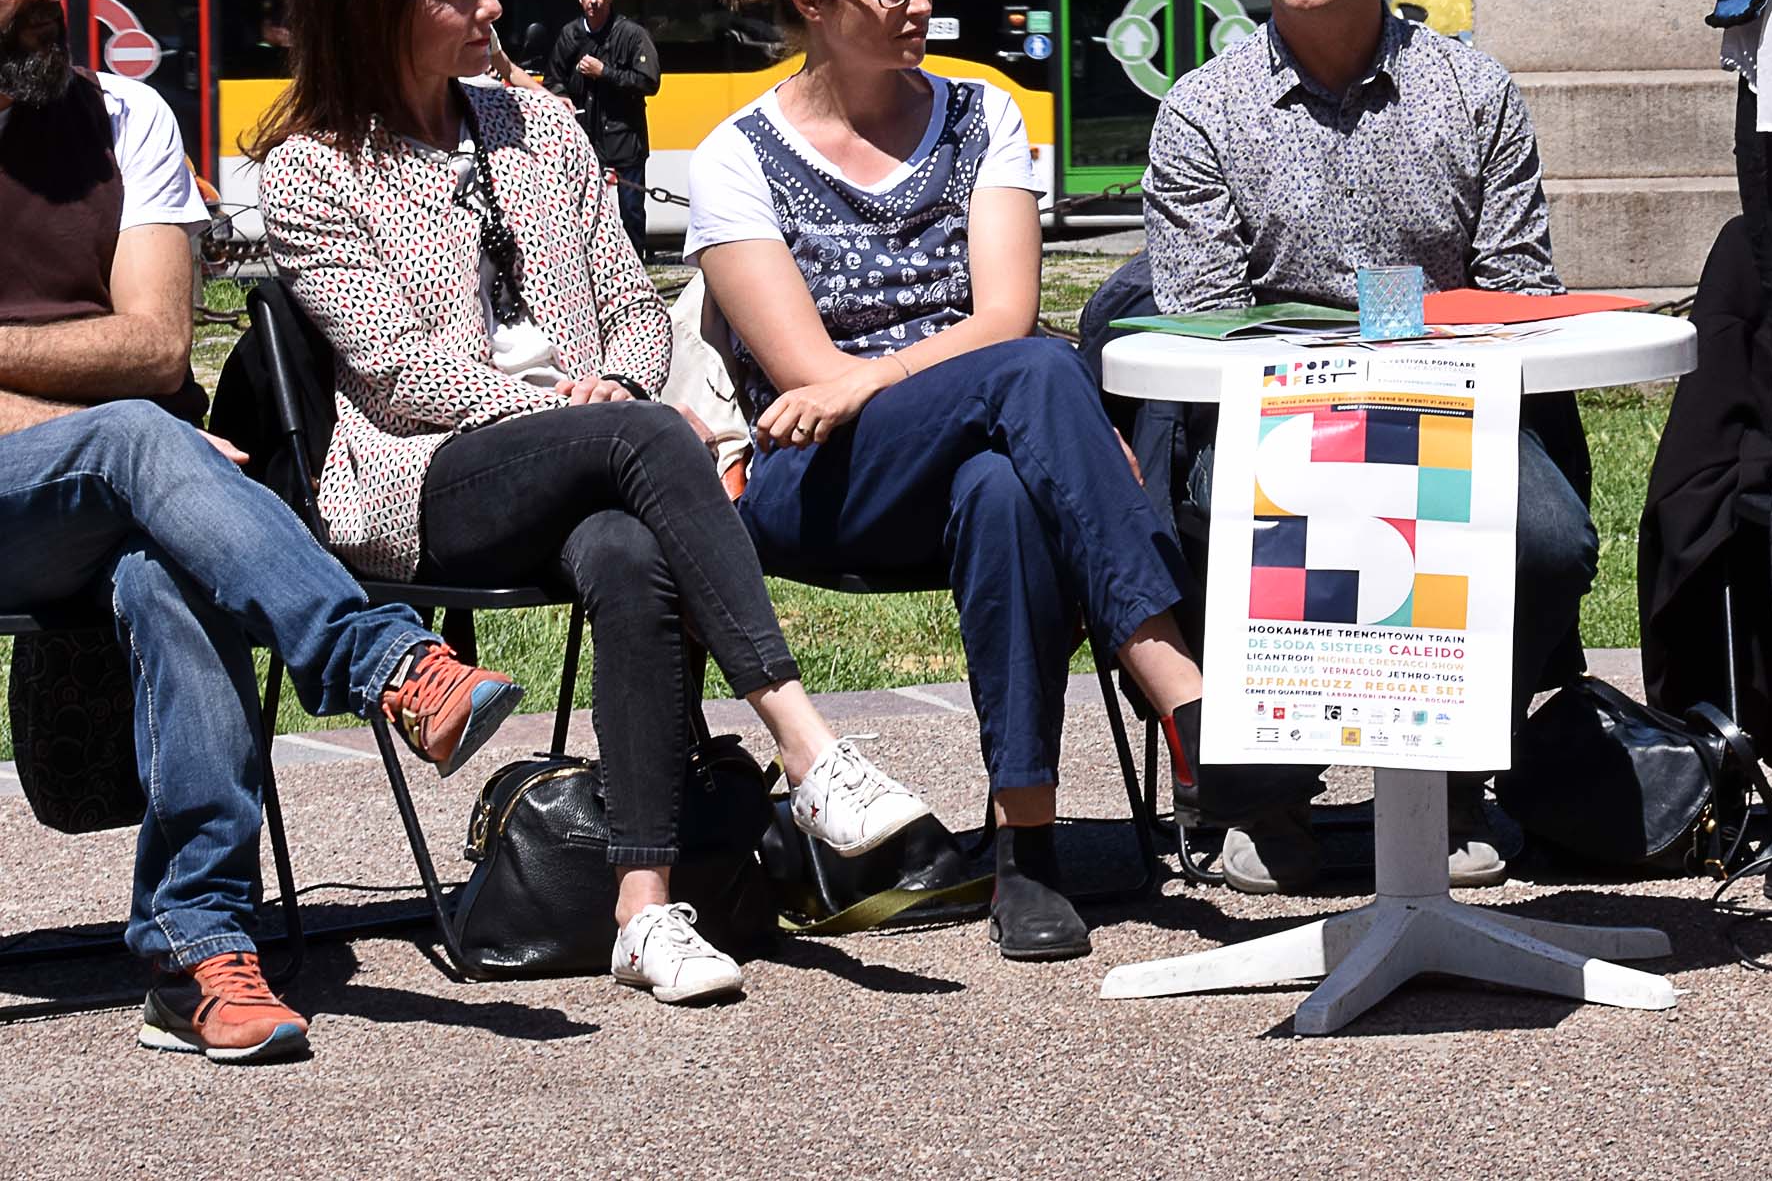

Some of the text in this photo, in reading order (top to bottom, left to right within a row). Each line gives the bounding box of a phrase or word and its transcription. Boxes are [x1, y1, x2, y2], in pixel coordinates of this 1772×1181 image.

[1294, 359, 1357, 371] POPUP
[1432, 359, 1475, 367] POPOLARE
[1293, 372, 1357, 386] FEST
[1249, 626, 1465, 643] HOOKAH&THE TRENCHTOWN TRAIN
[1273, 639, 1315, 651] SODA
[1321, 642, 1383, 654] SISTERS
[1389, 645, 1464, 659] CALEIDO
[1247, 653, 1313, 662] LICANTROPI
[1432, 661, 1464, 671] SHOW
[1322, 667, 1382, 677] VERNACOLO
[1387, 671, 1464, 682] JETHRO-TUGS
[1246, 677, 1465, 696] DJFRANCUZZ REGGAE SET
